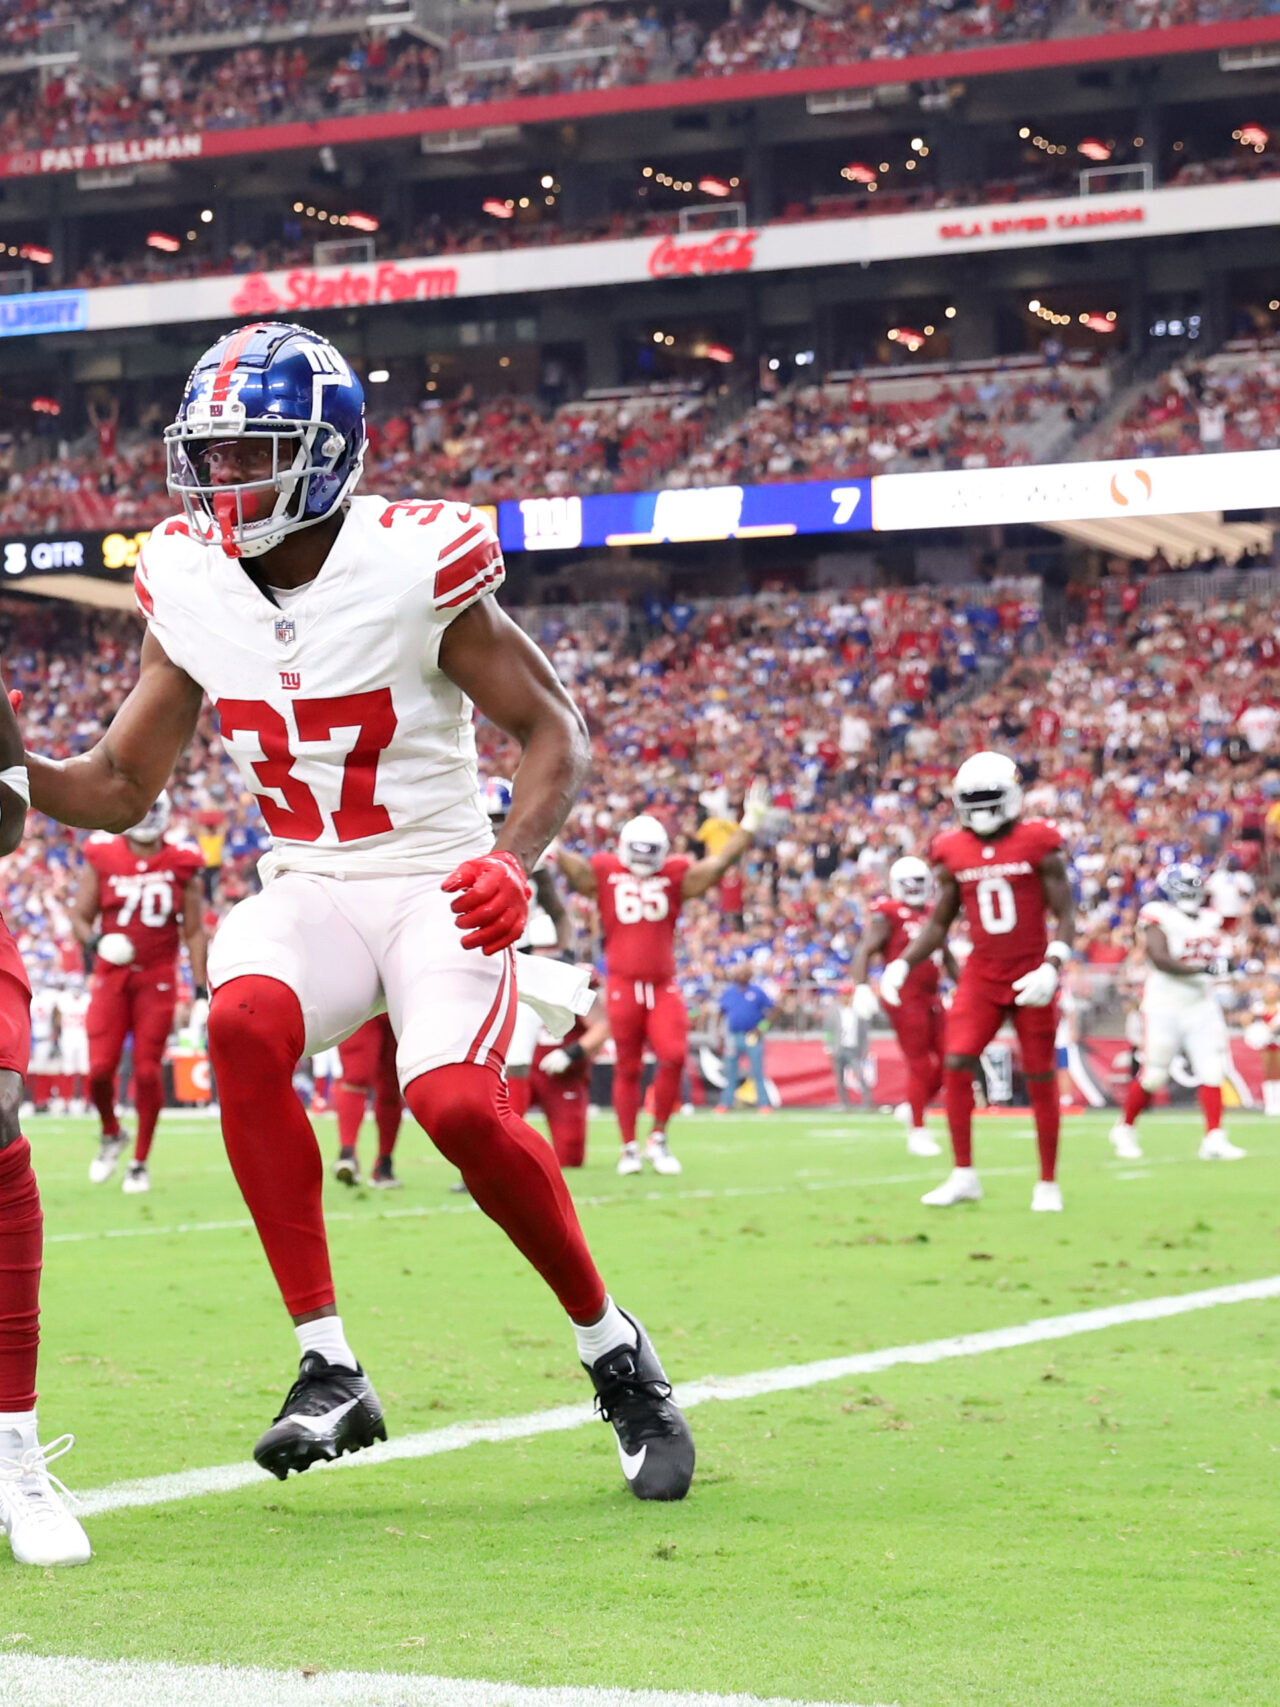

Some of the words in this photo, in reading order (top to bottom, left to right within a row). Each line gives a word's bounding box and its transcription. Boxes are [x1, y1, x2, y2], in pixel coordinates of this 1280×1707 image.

[40, 145, 89, 172] PAT
[92, 134, 202, 166] TILLMAN
[285, 268, 370, 311] State
[375, 260, 458, 302] Farm
[831, 487, 861, 524] 7
[4, 543, 27, 574] 3
[31, 541, 84, 570] QTR
[215, 686, 398, 842] 37
[114, 881, 174, 928] 70
[613, 882, 670, 924] 65
[976, 876, 1018, 935] 0
